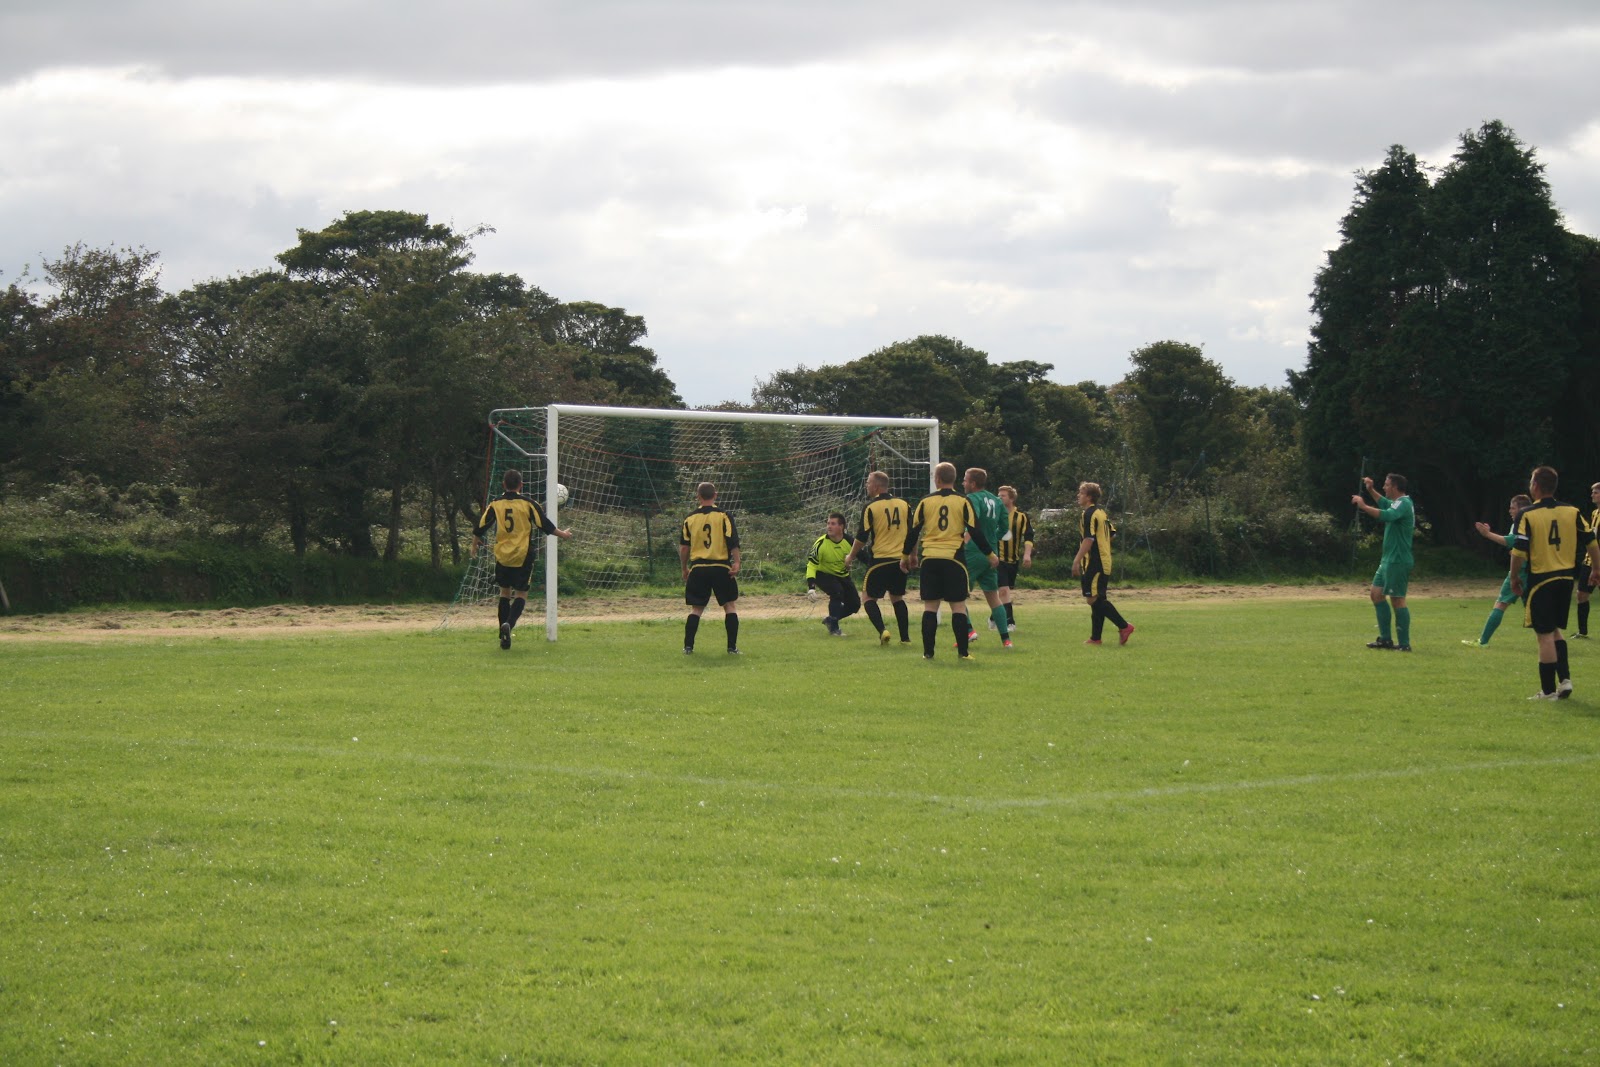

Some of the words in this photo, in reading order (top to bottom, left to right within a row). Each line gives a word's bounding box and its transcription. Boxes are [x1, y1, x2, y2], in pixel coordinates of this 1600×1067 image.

[504, 508, 514, 533] 5
[885, 506, 900, 531] 14
[938, 505, 949, 531] 8
[702, 523, 712, 549] 3
[1548, 519, 1561, 552] 4
